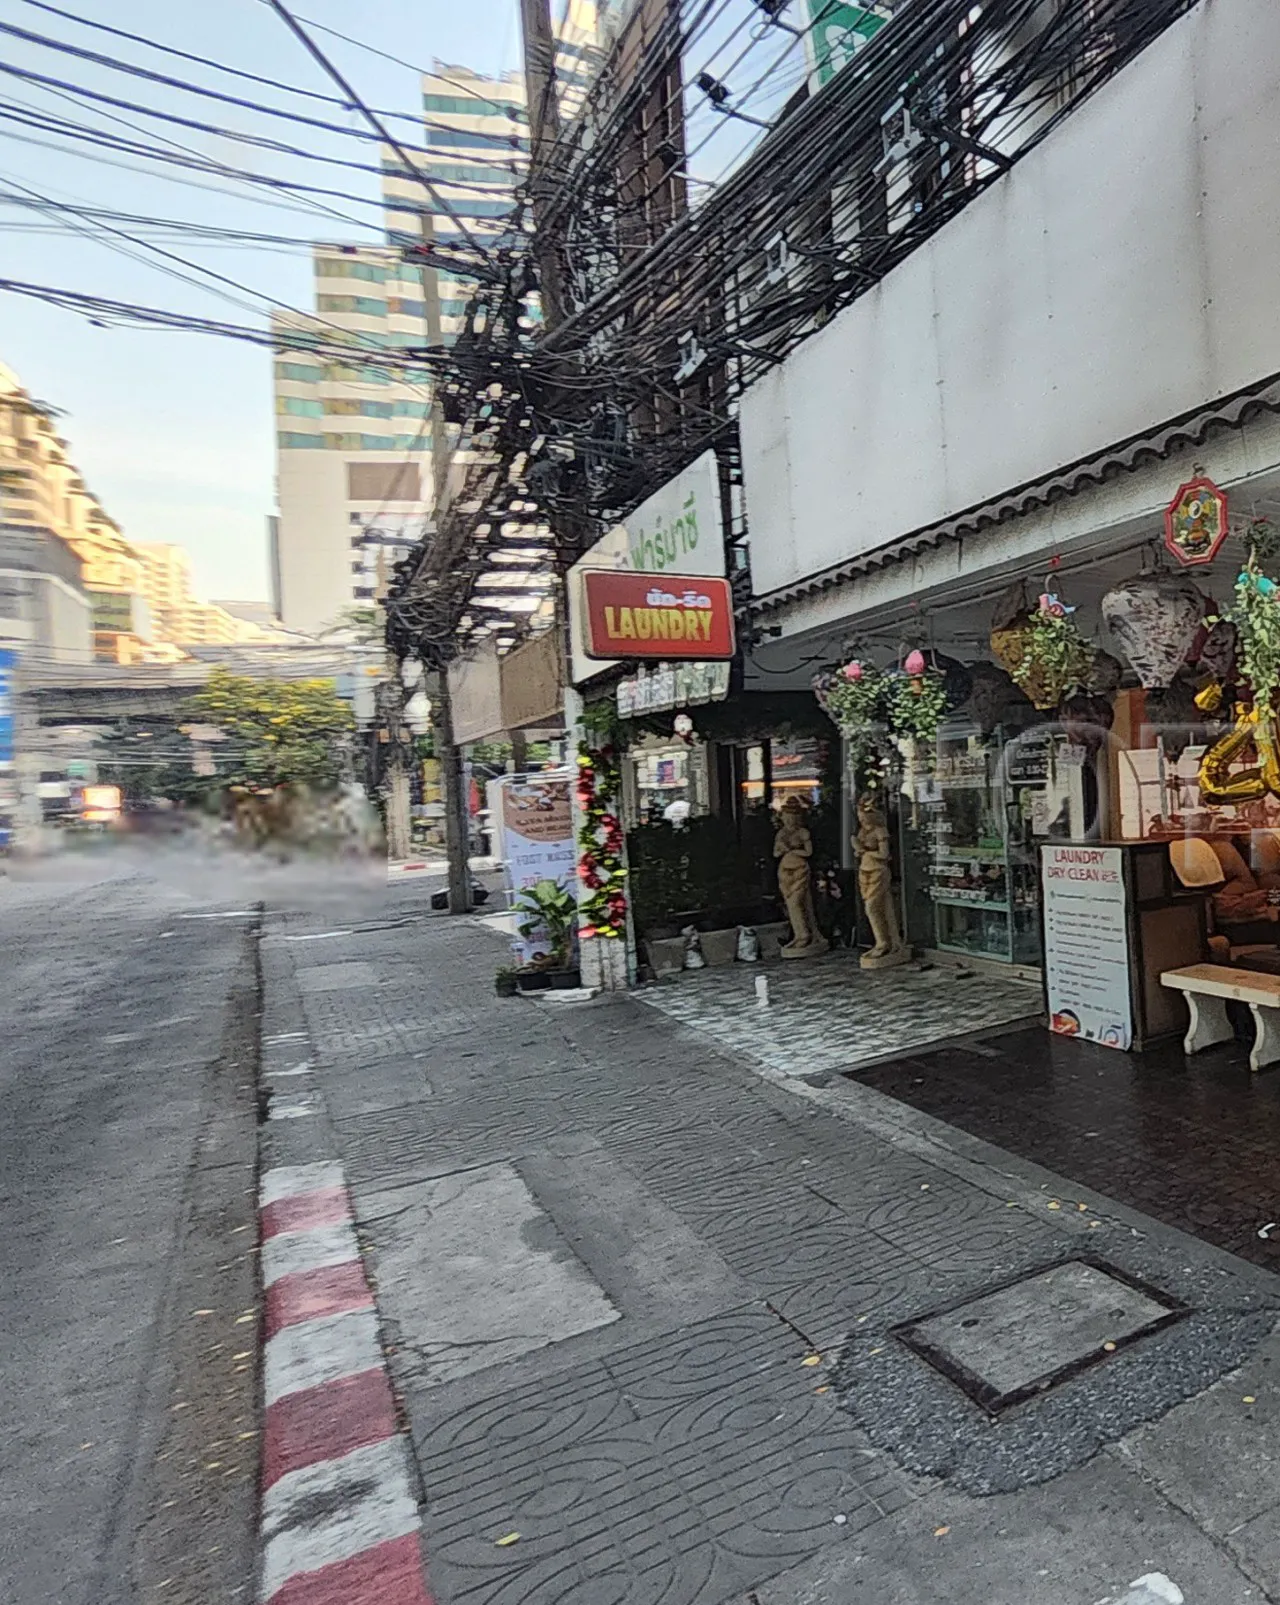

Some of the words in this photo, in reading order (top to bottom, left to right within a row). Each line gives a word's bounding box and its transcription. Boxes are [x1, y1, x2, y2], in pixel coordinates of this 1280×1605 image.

[604, 606, 713, 642] LAUNDRY
[1054, 849, 1105, 865] LAUNDRY
[1047, 866, 1065, 879] DRY
[1068, 867, 1100, 882] CLEAN
